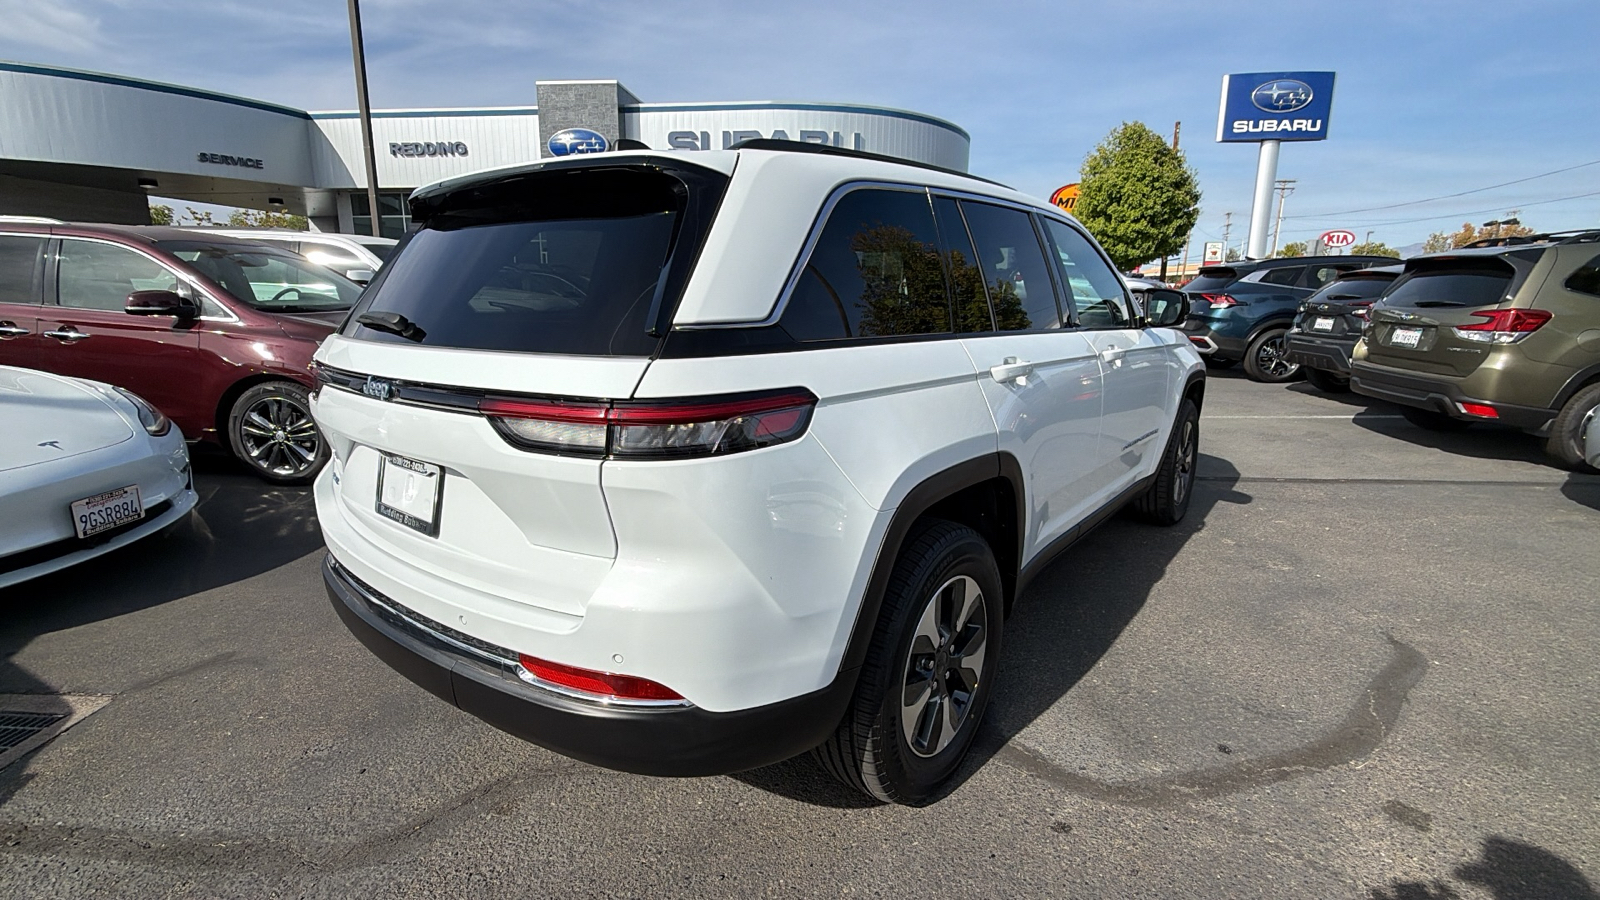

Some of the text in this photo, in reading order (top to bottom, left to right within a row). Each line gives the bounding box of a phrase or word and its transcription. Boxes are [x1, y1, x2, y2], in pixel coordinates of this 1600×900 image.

[1232, 119, 1322, 133] SUBARU
[389, 141, 468, 158] REDDING
[197, 152, 264, 170] SERVICE
[1327, 234, 1349, 245] KIA
[362, 376, 389, 401] Jeep
[291, 392, 310, 406] IRO
[79, 500, 138, 532] 9GSR884
